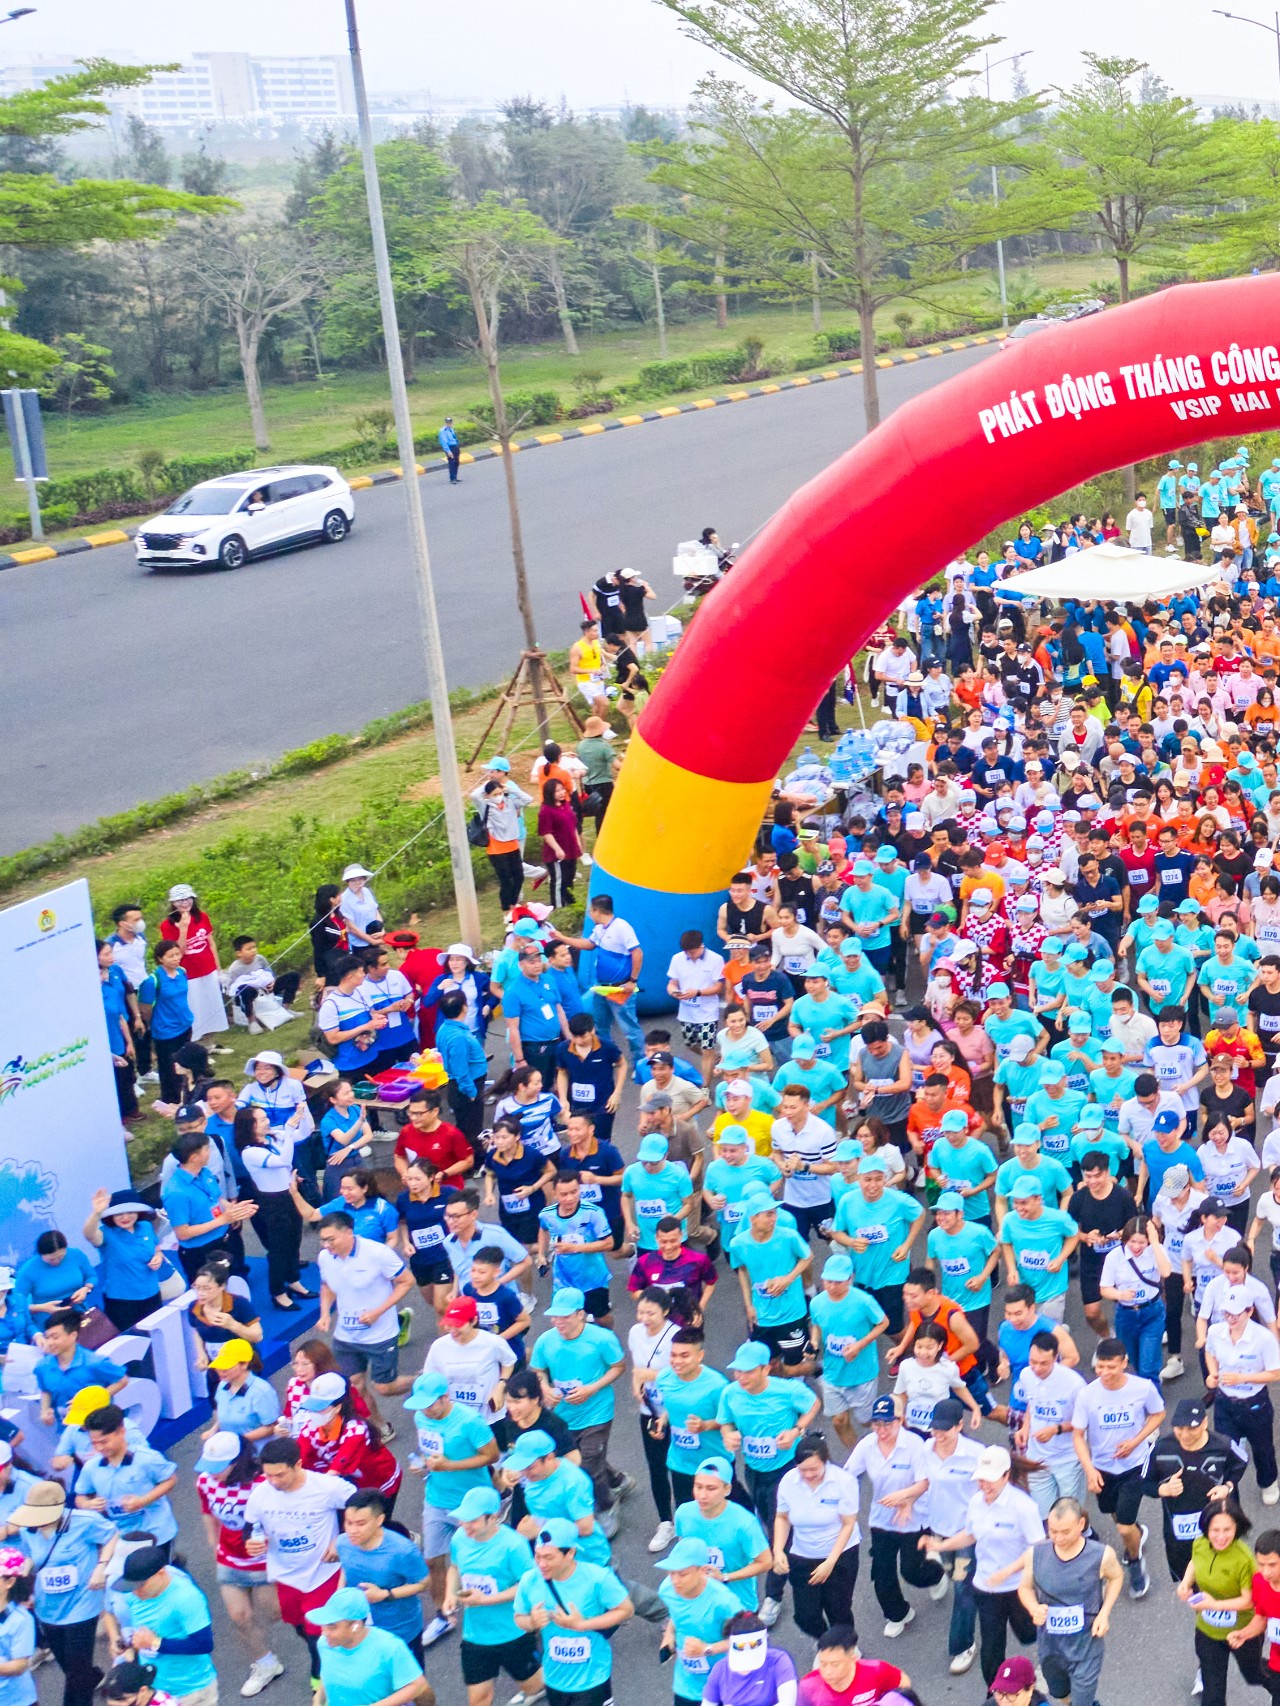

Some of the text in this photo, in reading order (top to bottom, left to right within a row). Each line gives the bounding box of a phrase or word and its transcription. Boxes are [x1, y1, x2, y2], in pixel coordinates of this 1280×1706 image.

[979, 390, 1042, 443] PHÁT
[1045, 372, 1116, 421] ĐỘNG
[1120, 354, 1206, 400] THÁNG
[1170, 396, 1222, 421] VSIP
[1231, 391, 1271, 413] HAI
[454, 1389, 476, 1401] 1419
[1103, 1411, 1129, 1423] 0075
[1050, 1614, 1078, 1627] 0289
